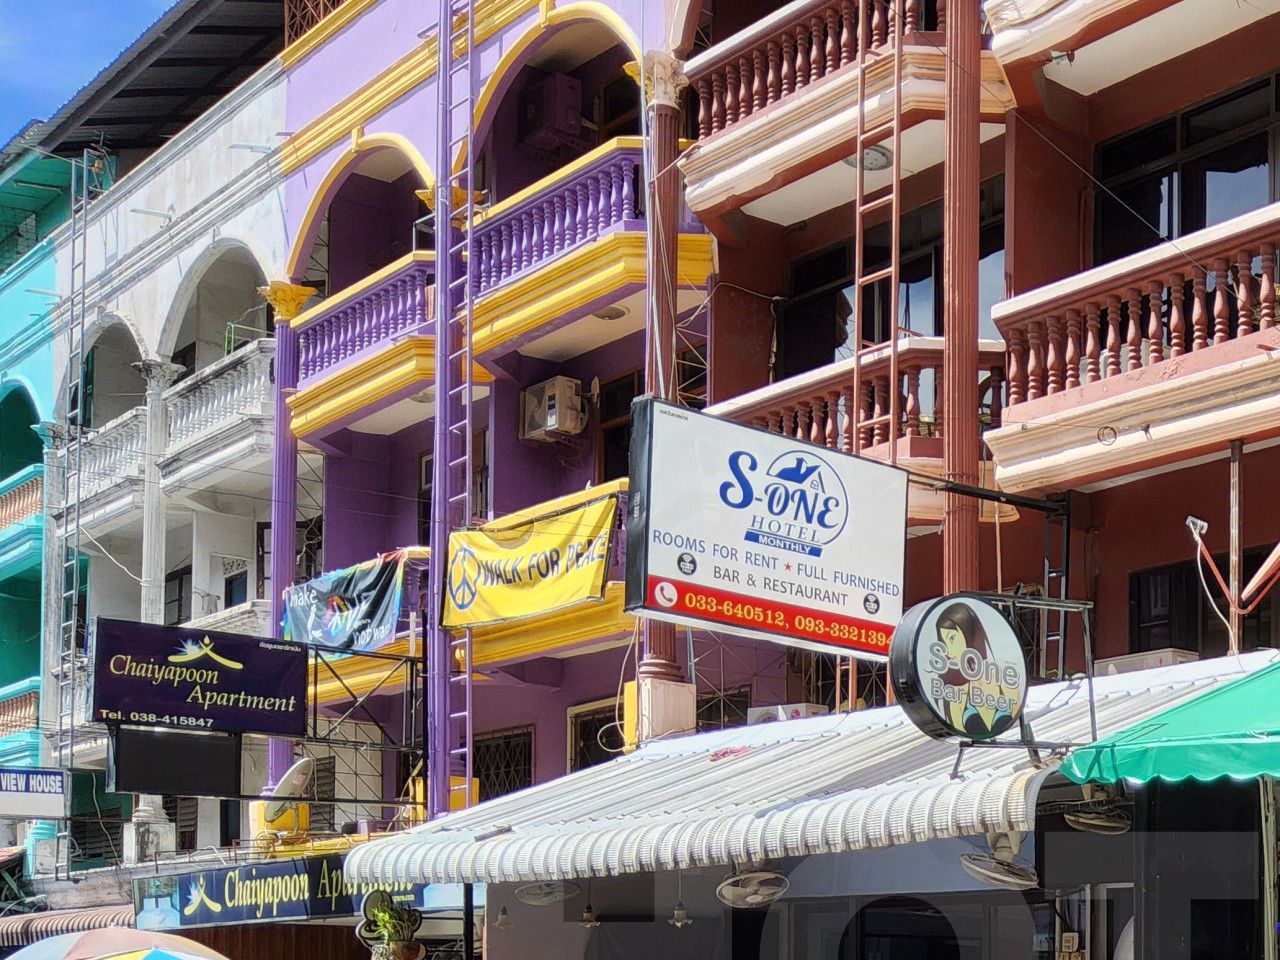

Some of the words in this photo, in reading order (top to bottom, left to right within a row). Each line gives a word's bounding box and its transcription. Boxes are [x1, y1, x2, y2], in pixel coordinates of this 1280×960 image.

[750, 514, 821, 543] HOTEL
[758, 534, 813, 556] MONTHLY
[480, 557, 522, 587] WALK
[527, 547, 561, 580] FOR
[566, 530, 608, 573] PEACE
[652, 529, 706, 554] ROOMS
[713, 543, 738, 563] FOR
[745, 551, 779, 571] RENT
[797, 563, 828, 582] FULL
[833, 571, 900, 598] FURNISHED
[713, 565, 741, 585] BAR
[746, 573, 757, 588] &
[764, 577, 848, 608] RESTAURANT
[110, 654, 219, 687] Chaiyapoon
[929, 641, 1020, 689] S-One
[186, 685, 296, 712] Apartment
[930, 677, 966, 704] Bar
[970, 686, 1016, 714] Beer
[99, 709, 126, 720] Tel.
[130, 713, 214, 728] 038-415847
[0, 773, 26, 791] VIEW
[29, 774, 63, 793] HOUSE
[224, 868, 310, 918] Chaiyapoon
